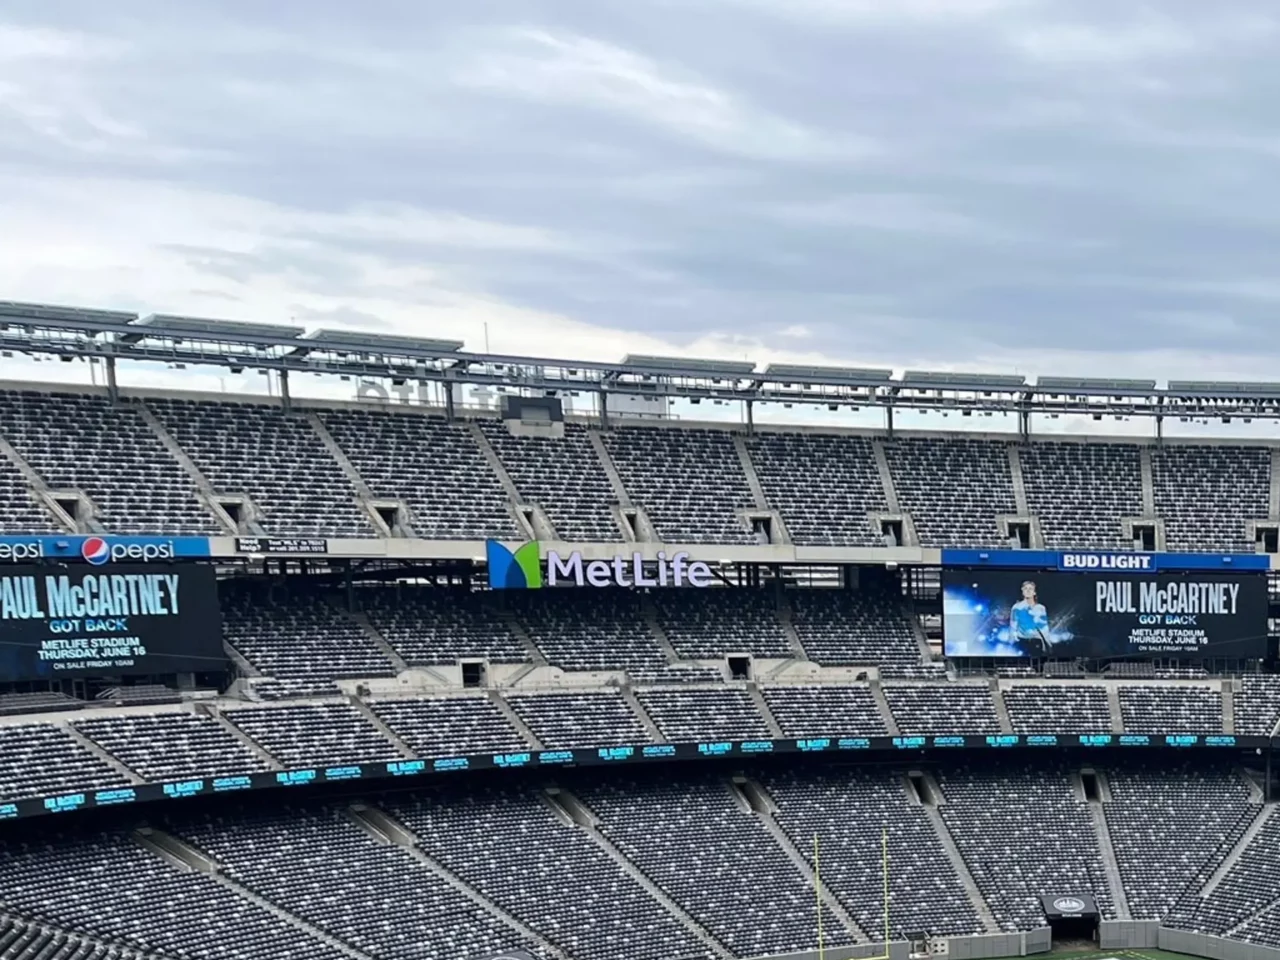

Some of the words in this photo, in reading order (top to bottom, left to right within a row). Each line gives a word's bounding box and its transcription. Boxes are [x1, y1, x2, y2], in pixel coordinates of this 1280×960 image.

[111, 540, 174, 562] pepsi
[1063, 554, 1099, 568] BUD
[1102, 555, 1151, 569] LIGHT
[547, 551, 711, 588] MetLife
[0, 576, 45, 619] AUL
[46, 574, 179, 617] McCARTNEY
[1096, 581, 1136, 613] PAUL
[1140, 582, 1239, 614] McCARTNEY
[50, 619, 81, 633] GOT
[85, 618, 128, 632] BACK
[1139, 615, 1161, 625] GOT
[1165, 615, 1197, 625] BACK
[1132, 628, 1166, 637] METLIFE
[1168, 629, 1204, 637] STADIUM
[41, 639, 88, 650] METLIFE
[90, 637, 140, 647] STADIUM
[1128, 636, 1174, 645] THURSDAY,
[1175, 636, 1197, 644] JUNE
[37, 649, 99, 660] THURSDAY,
[101, 648, 130, 657] JUNE
[133, 647, 146, 656] 16
[53, 662, 65, 670] ON
